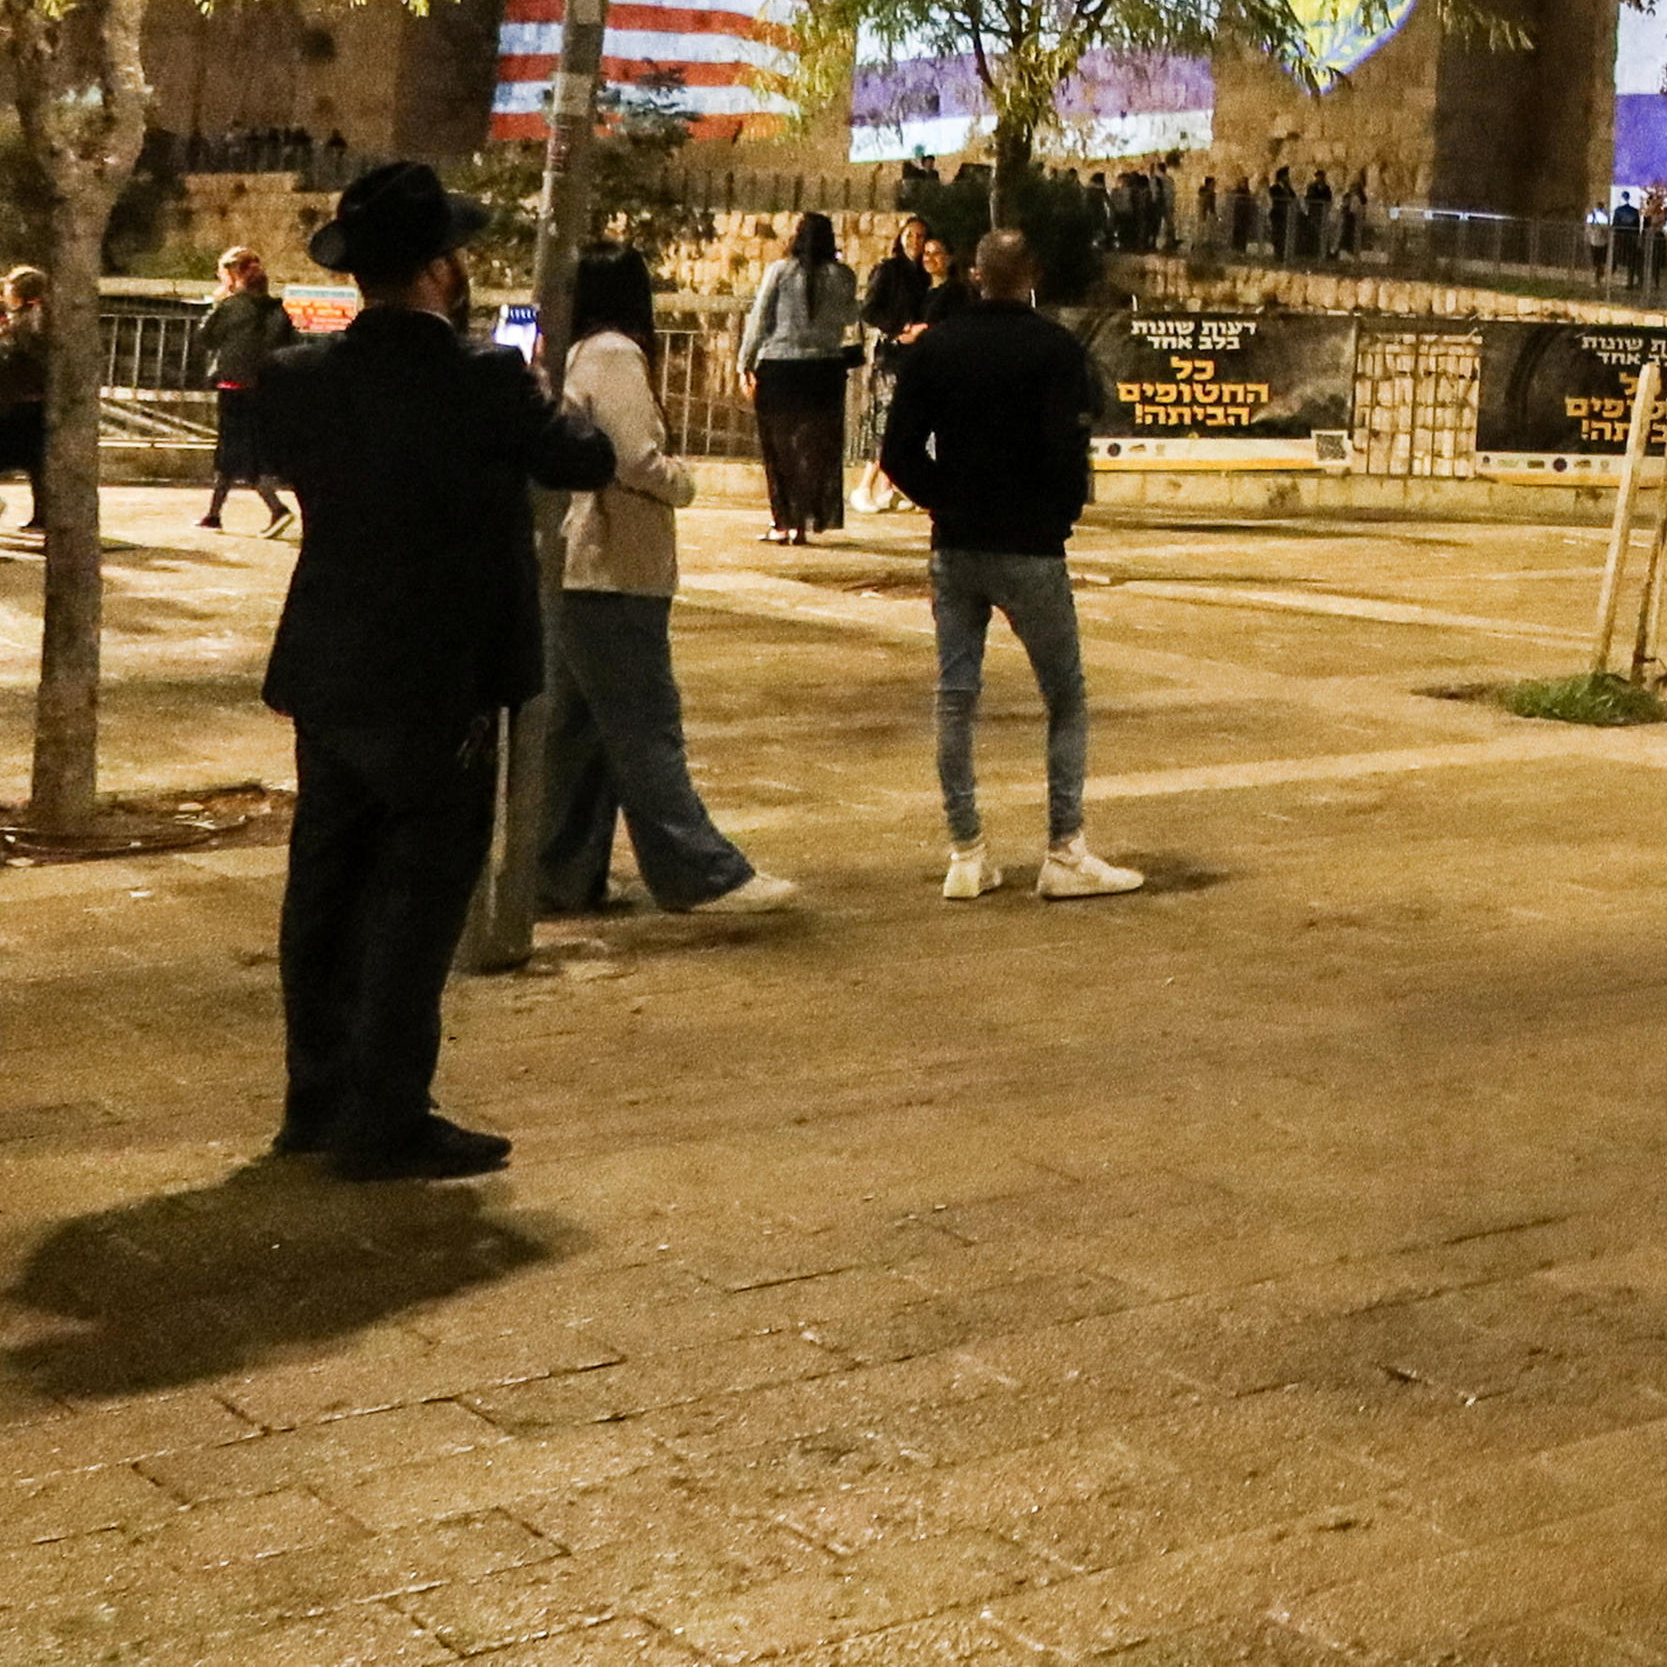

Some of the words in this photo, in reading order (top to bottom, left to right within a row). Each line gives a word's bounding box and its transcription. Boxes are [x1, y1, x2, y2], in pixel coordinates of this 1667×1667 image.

[1131, 320, 1196, 335] שונות
[1201, 320, 1257, 336] דעות
[1147, 335, 1193, 350] אחד
[1198, 334, 1240, 350] בלב
[1581, 335, 1644, 352] שונות
[1597, 351, 1642, 366] אחד
[1170, 355, 1215, 381] כל
[1116, 382, 1269, 403] החטופים
[1134, 402, 1251, 426] הביתה!
